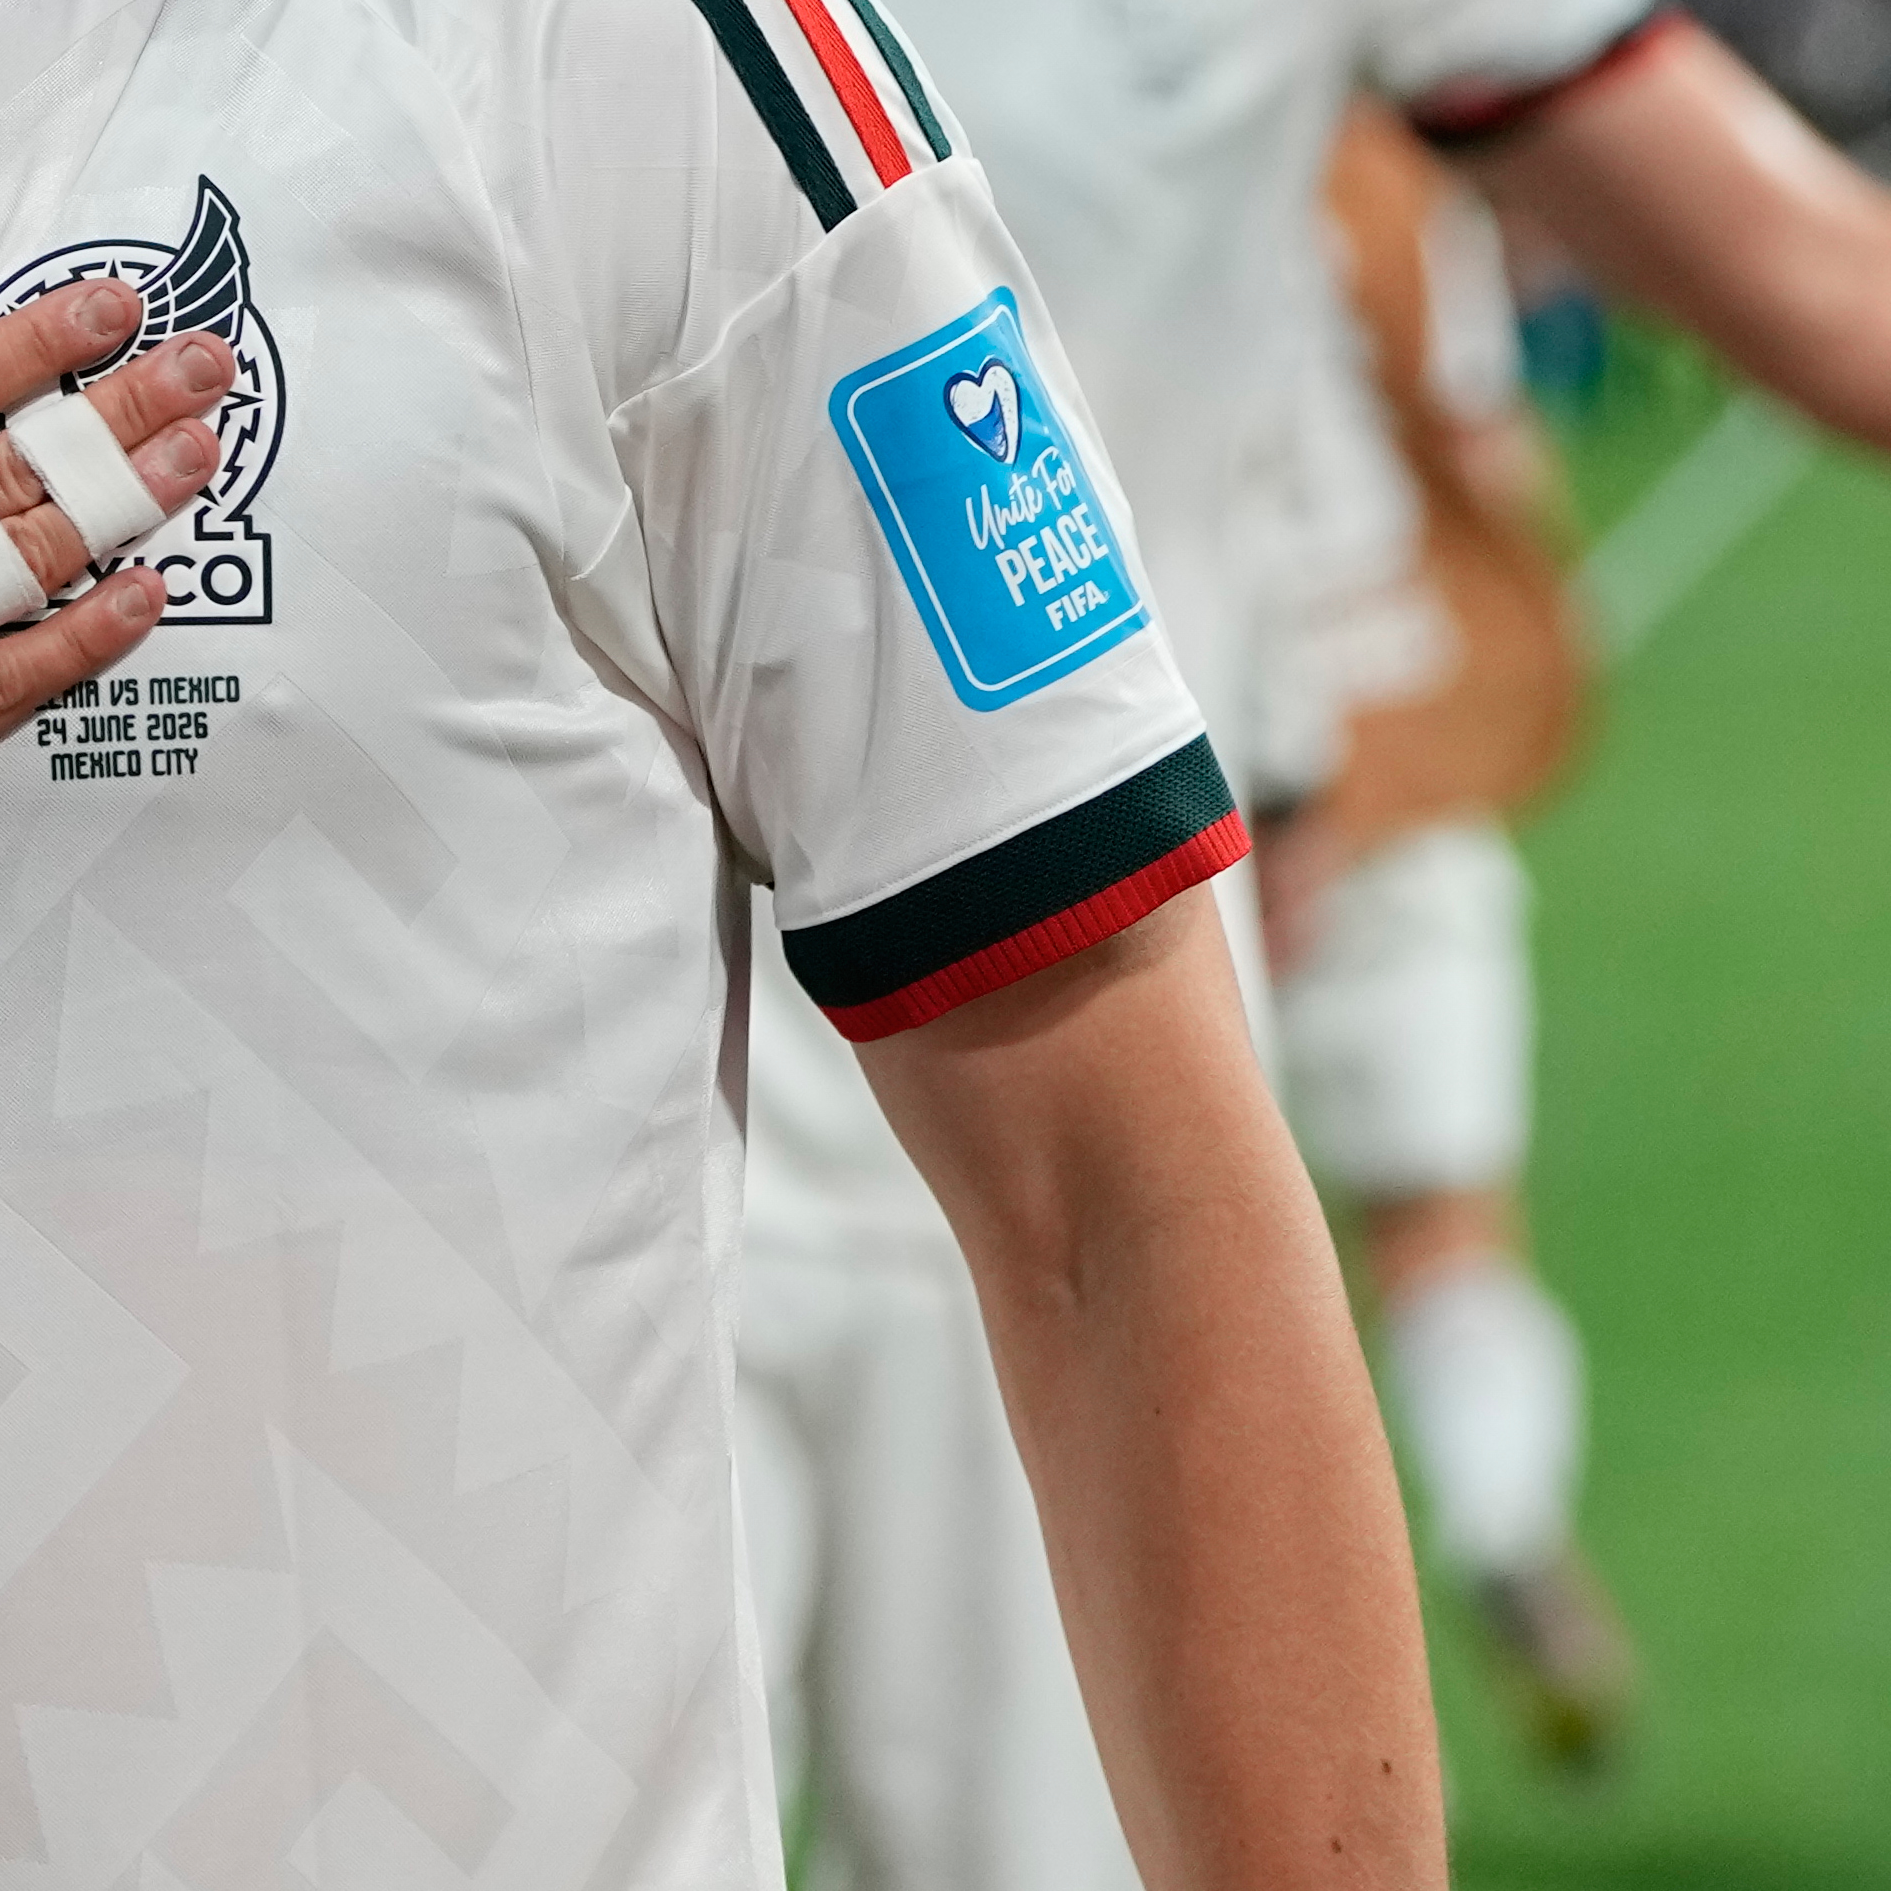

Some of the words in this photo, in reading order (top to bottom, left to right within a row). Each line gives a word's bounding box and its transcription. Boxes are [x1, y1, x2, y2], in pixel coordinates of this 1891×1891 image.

[965, 472, 1043, 550] Unite
[995, 502, 1109, 607] PEACE
[1045, 580, 1107, 631] FIFA
[110, 679, 139, 707] VS
[149, 675, 240, 706] MEXICO
[36, 718, 67, 747] 24
[76, 714, 137, 745] JUNE
[146, 711, 208, 741] 2026
[51, 749, 141, 781] MEXICO
[151, 747, 198, 776] CITY
